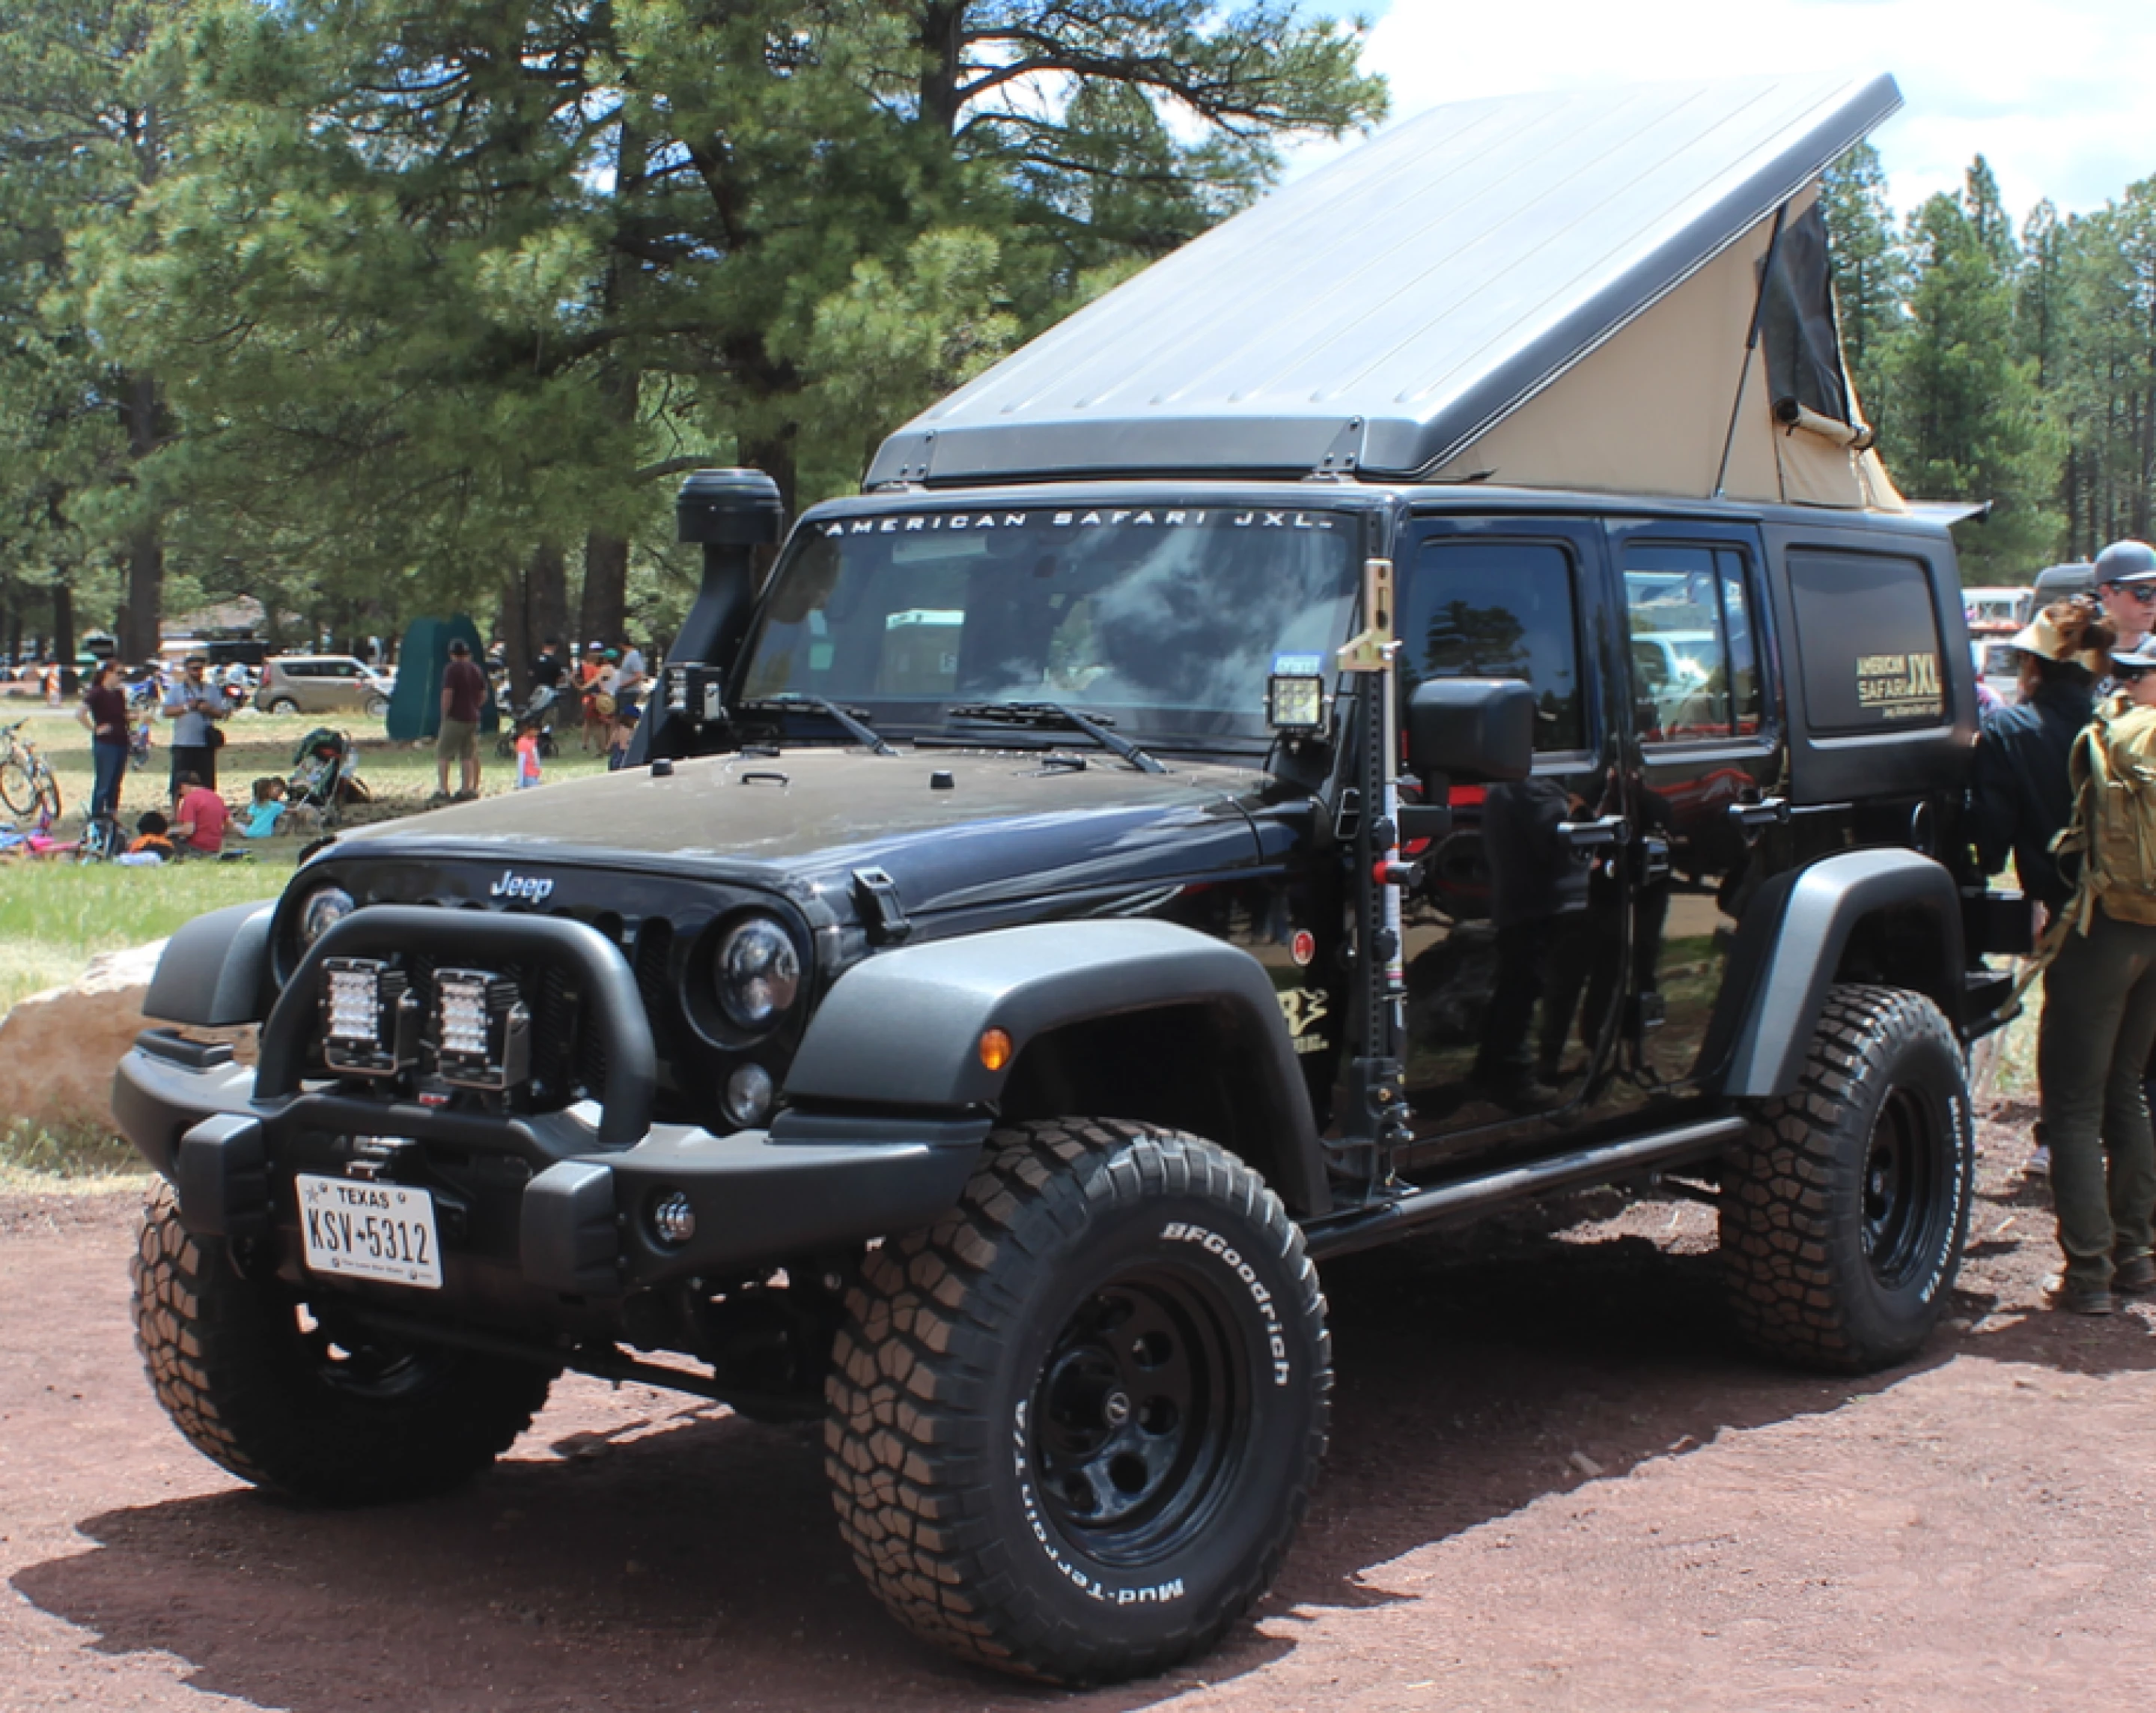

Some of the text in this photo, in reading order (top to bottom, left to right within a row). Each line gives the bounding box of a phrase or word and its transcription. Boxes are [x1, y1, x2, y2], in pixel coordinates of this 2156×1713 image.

[824, 511, 1026, 537] AMERICAN
[1053, 510, 1207, 526] SAFARI
[1856, 654, 1905, 676] AMERICAN
[1857, 654, 1943, 700] SAFARI JXL
[490, 869, 555, 905] Jeep
[337, 1185, 390, 1209] TEXAS
[1159, 1222, 1291, 1387] BFGoodrich
[1013, 1399, 1184, 1605] Mud-Terrain T/A
